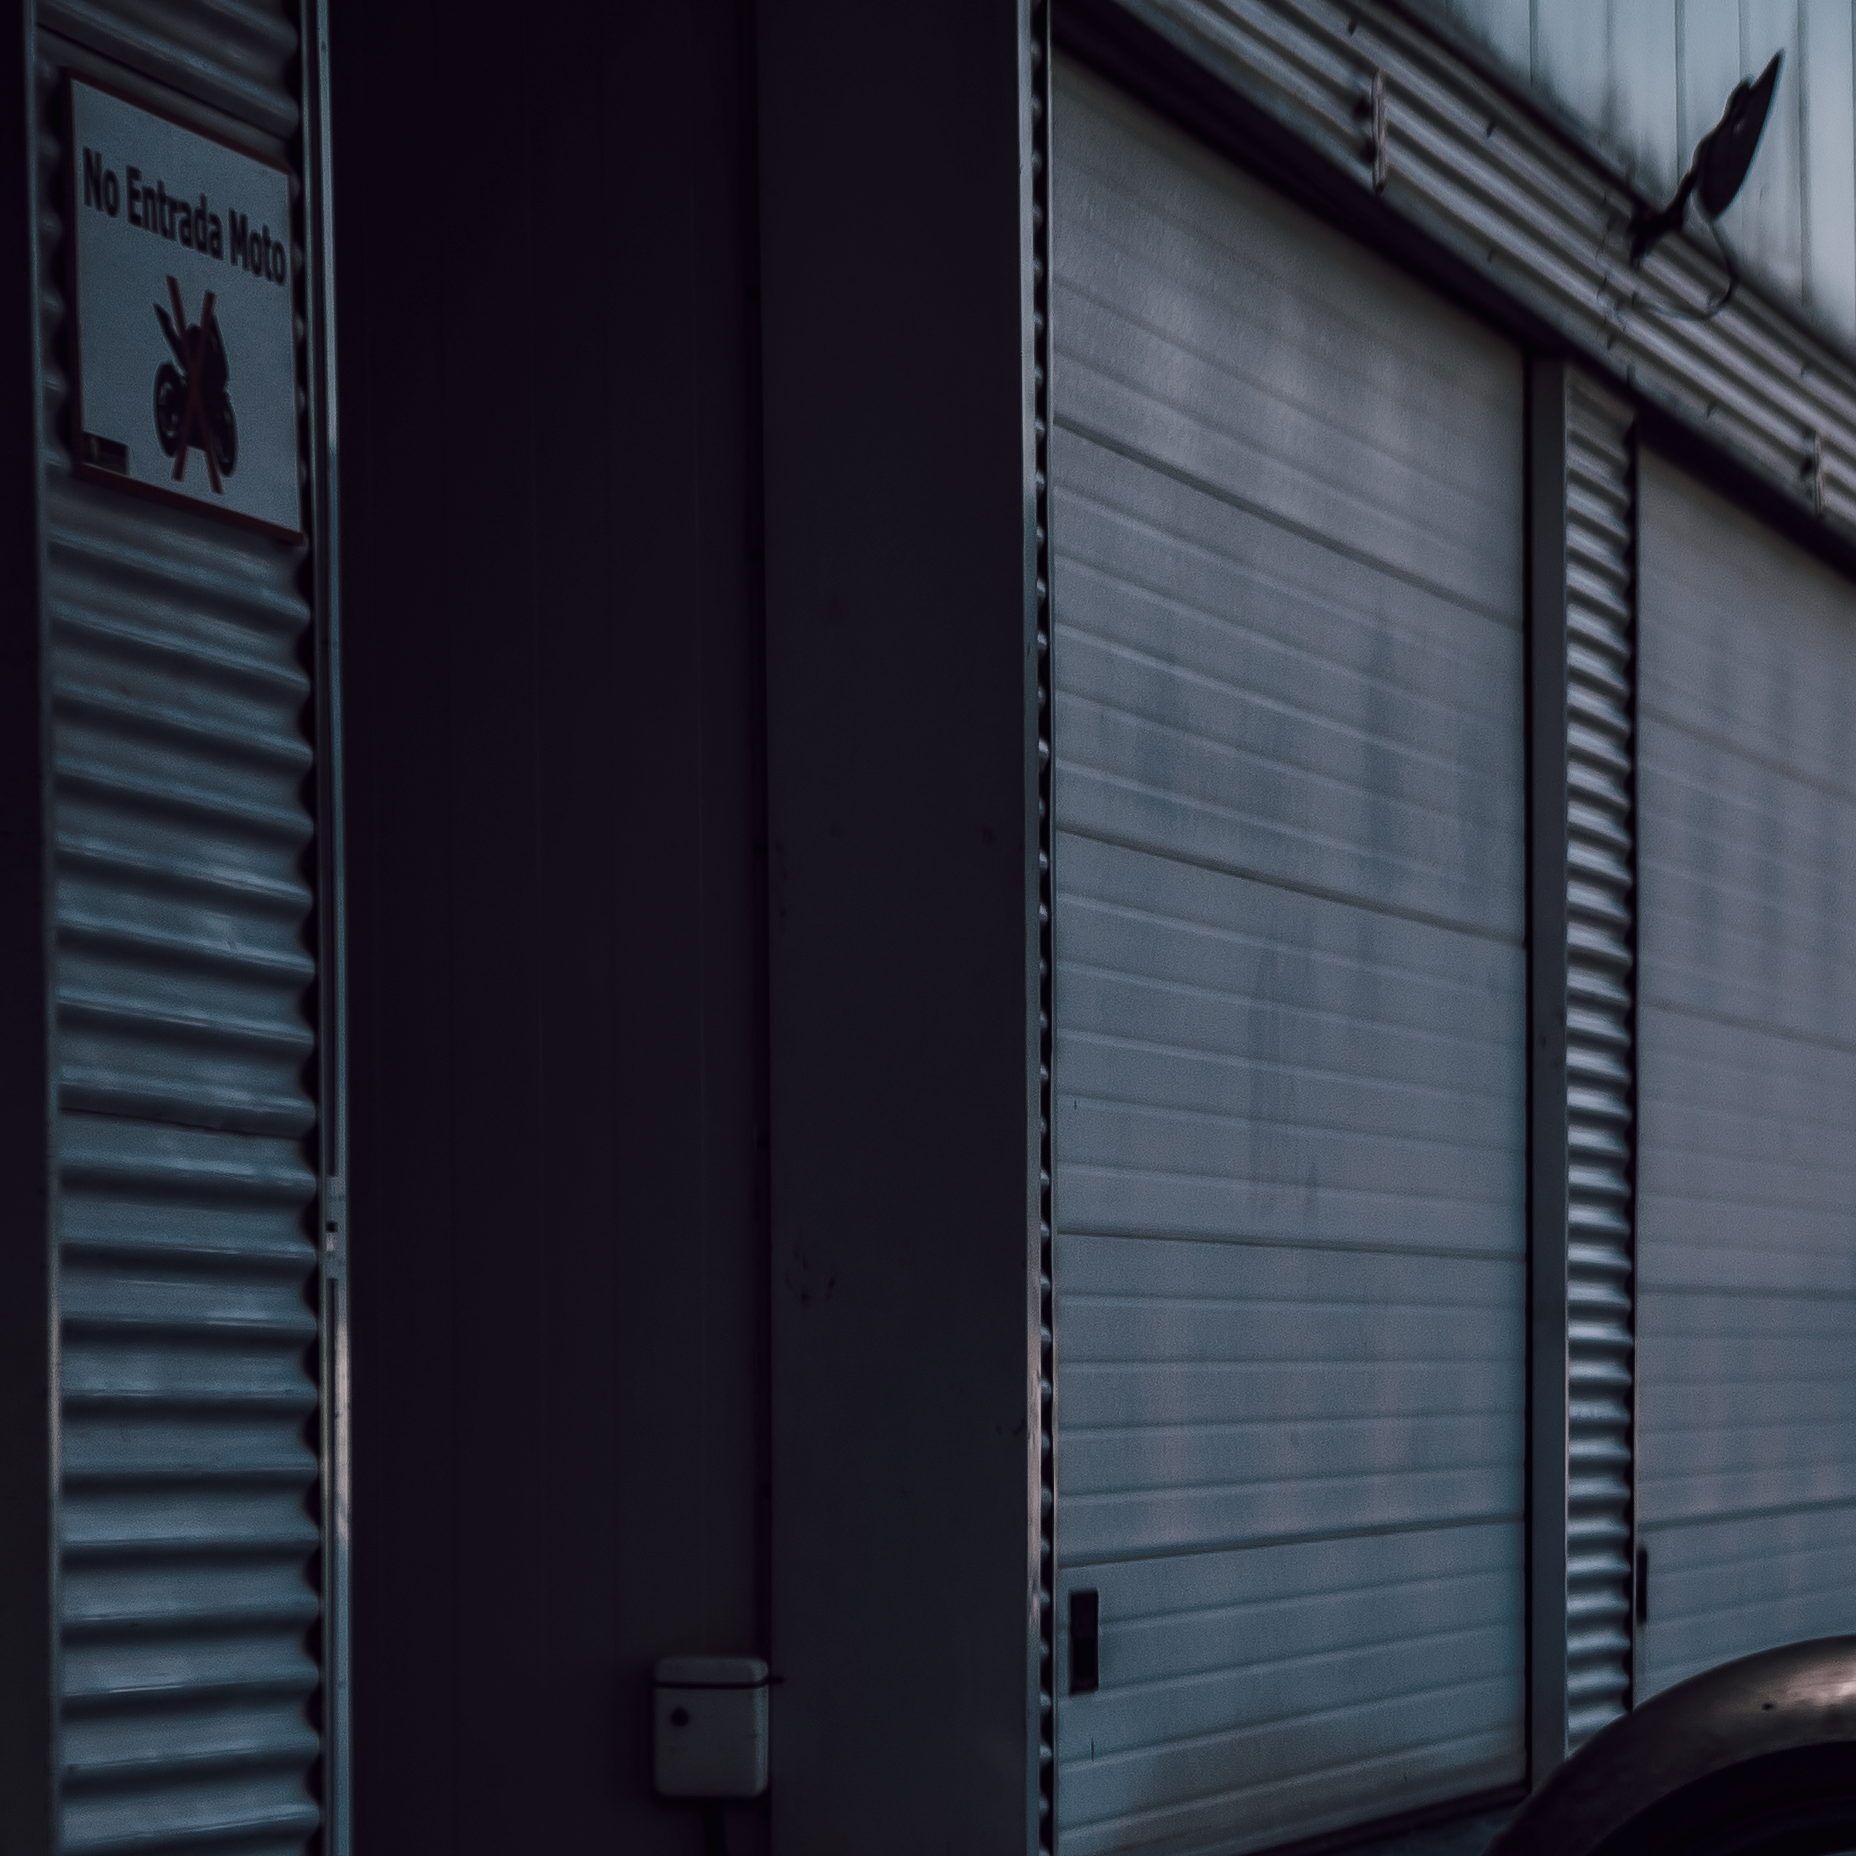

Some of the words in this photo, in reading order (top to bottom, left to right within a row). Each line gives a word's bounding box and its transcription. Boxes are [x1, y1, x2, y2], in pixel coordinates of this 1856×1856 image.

[83, 147, 119, 218] No
[126, 165, 224, 261] Entrada
[228, 207, 287, 286] Moto
